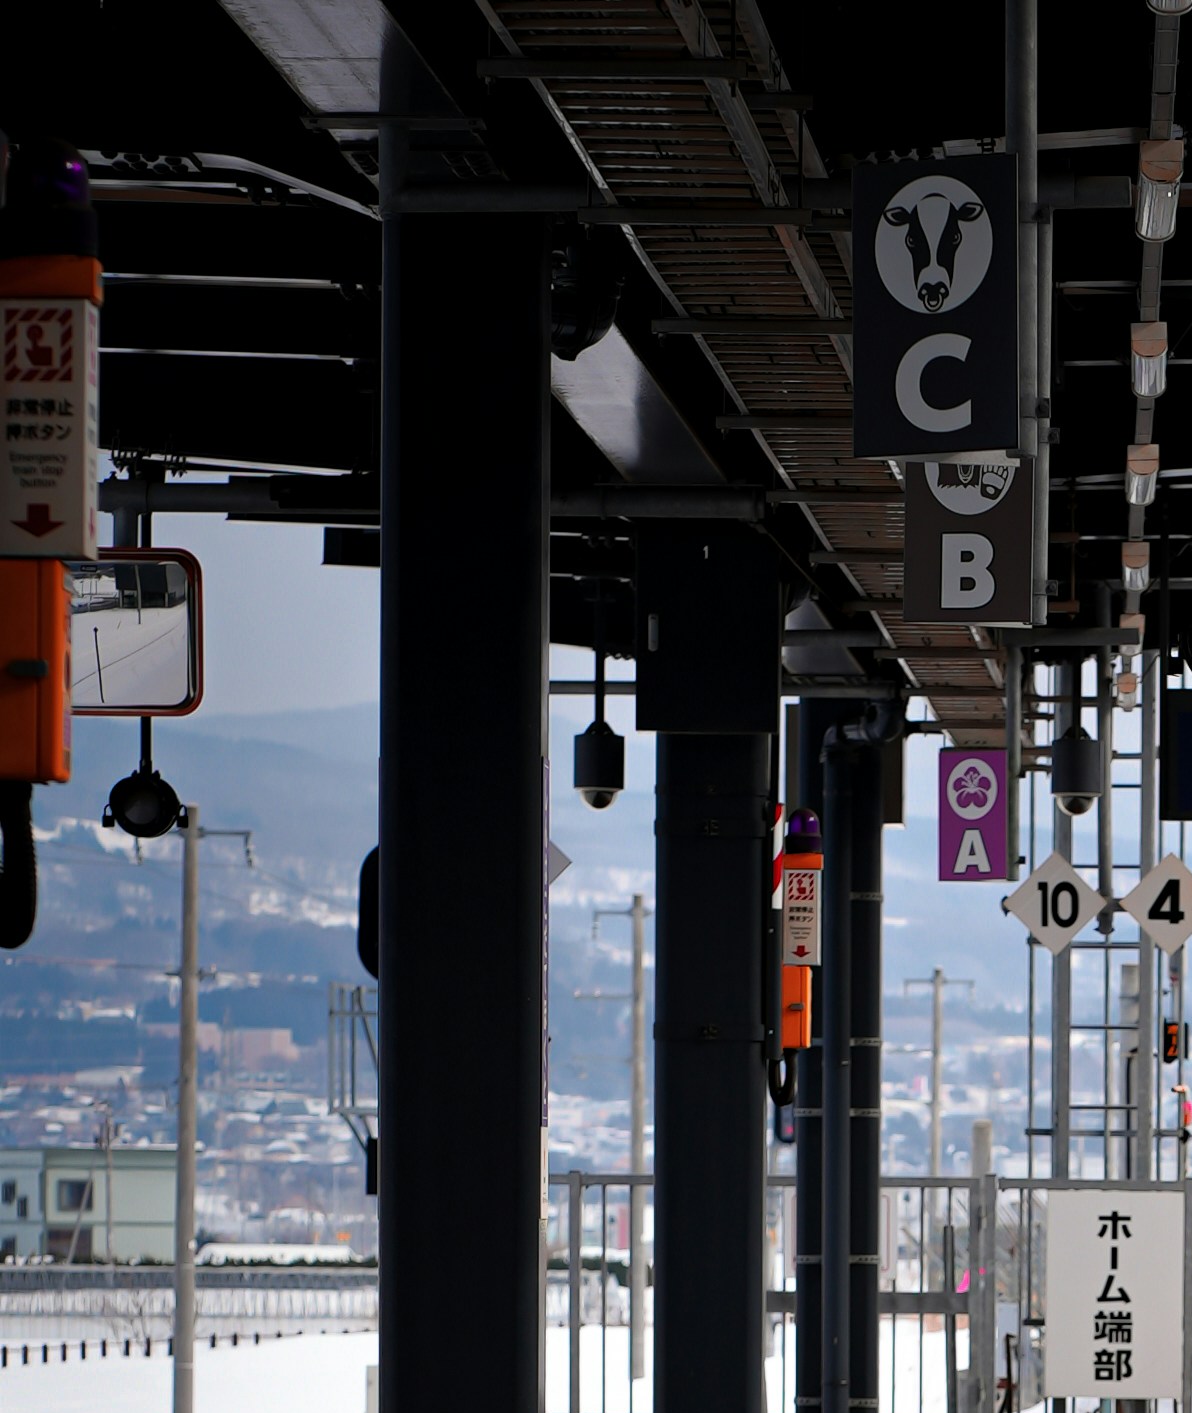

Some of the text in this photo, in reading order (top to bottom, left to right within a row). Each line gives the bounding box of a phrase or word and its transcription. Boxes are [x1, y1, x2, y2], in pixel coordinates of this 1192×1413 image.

[895, 333, 972, 432] C
[941, 533, 995, 609] B
[954, 829, 991, 873] A
[1037, 881, 1080, 929] 10
[1147, 879, 1185, 925] 4
[1093, 1210, 1133, 1382] ホーム端部
